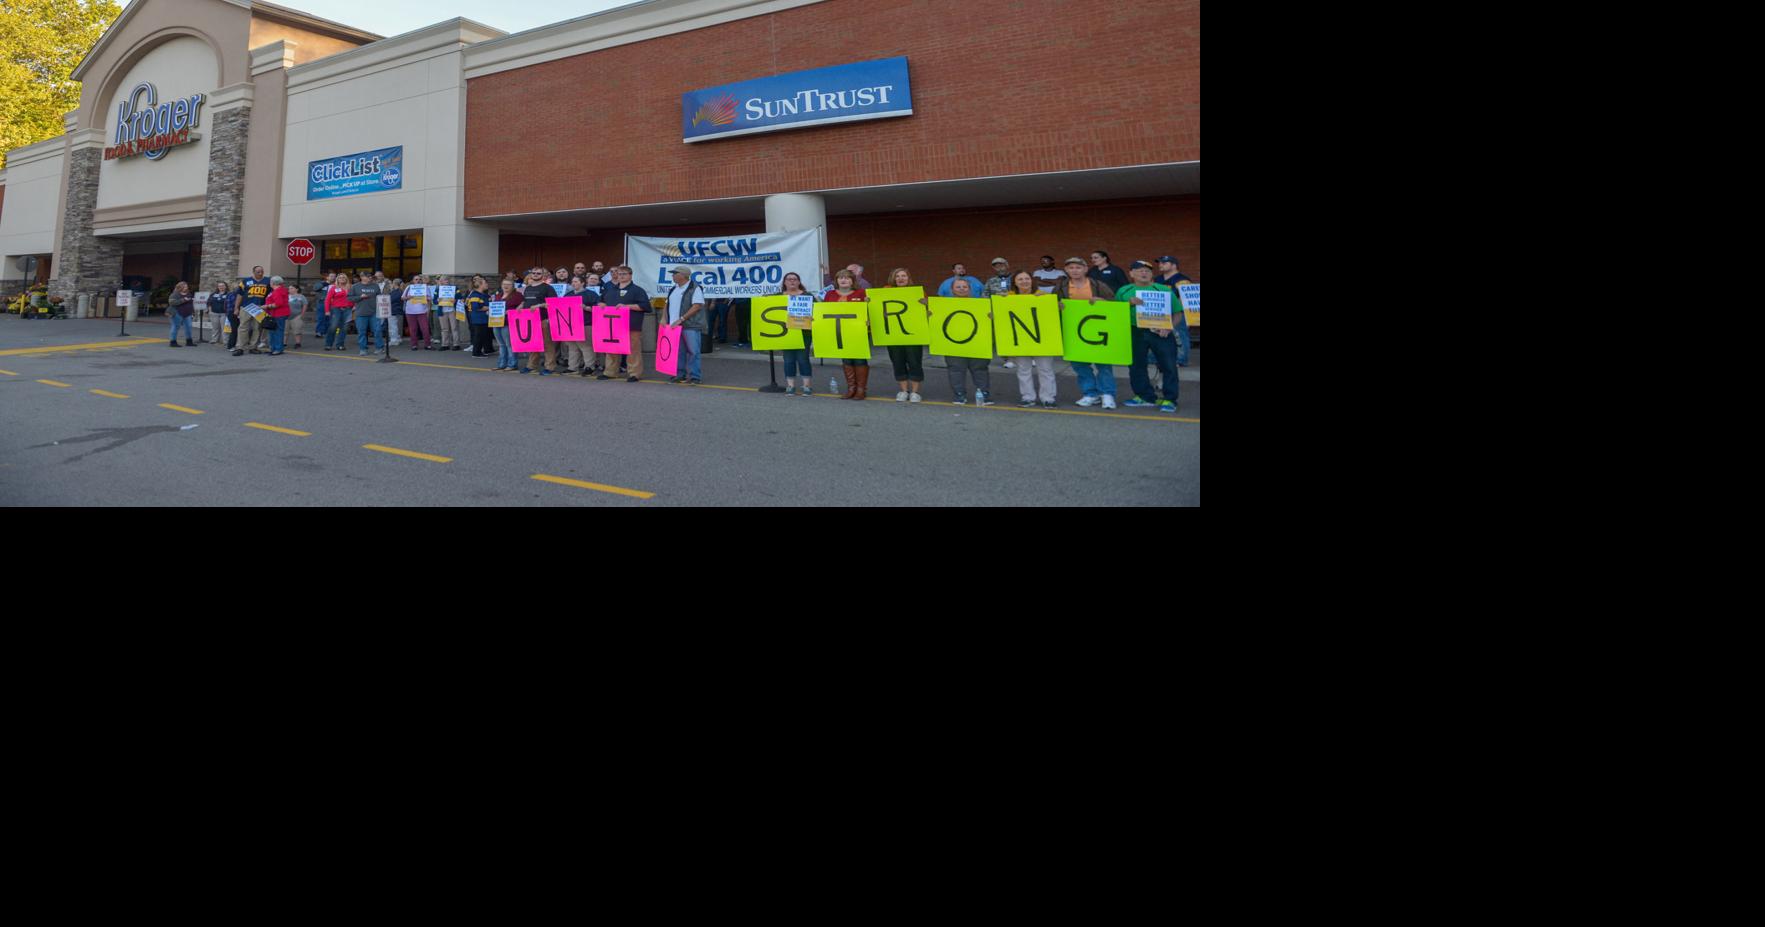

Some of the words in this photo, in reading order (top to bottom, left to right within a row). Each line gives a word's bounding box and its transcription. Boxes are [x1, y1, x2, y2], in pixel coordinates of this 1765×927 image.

[114, 81, 206, 160] Kroger
[136, 129, 189, 152] PHARMACY
[312, 156, 381, 183] ClickList
[288, 246, 313, 257] STOP
[678, 238, 757, 257] UFCW
[743, 254, 778, 262] America
[658, 266, 726, 285] Lcal
[731, 265, 783, 284] 400
[248, 285, 267, 296] 400
[734, 286, 762, 294] WORKERS
